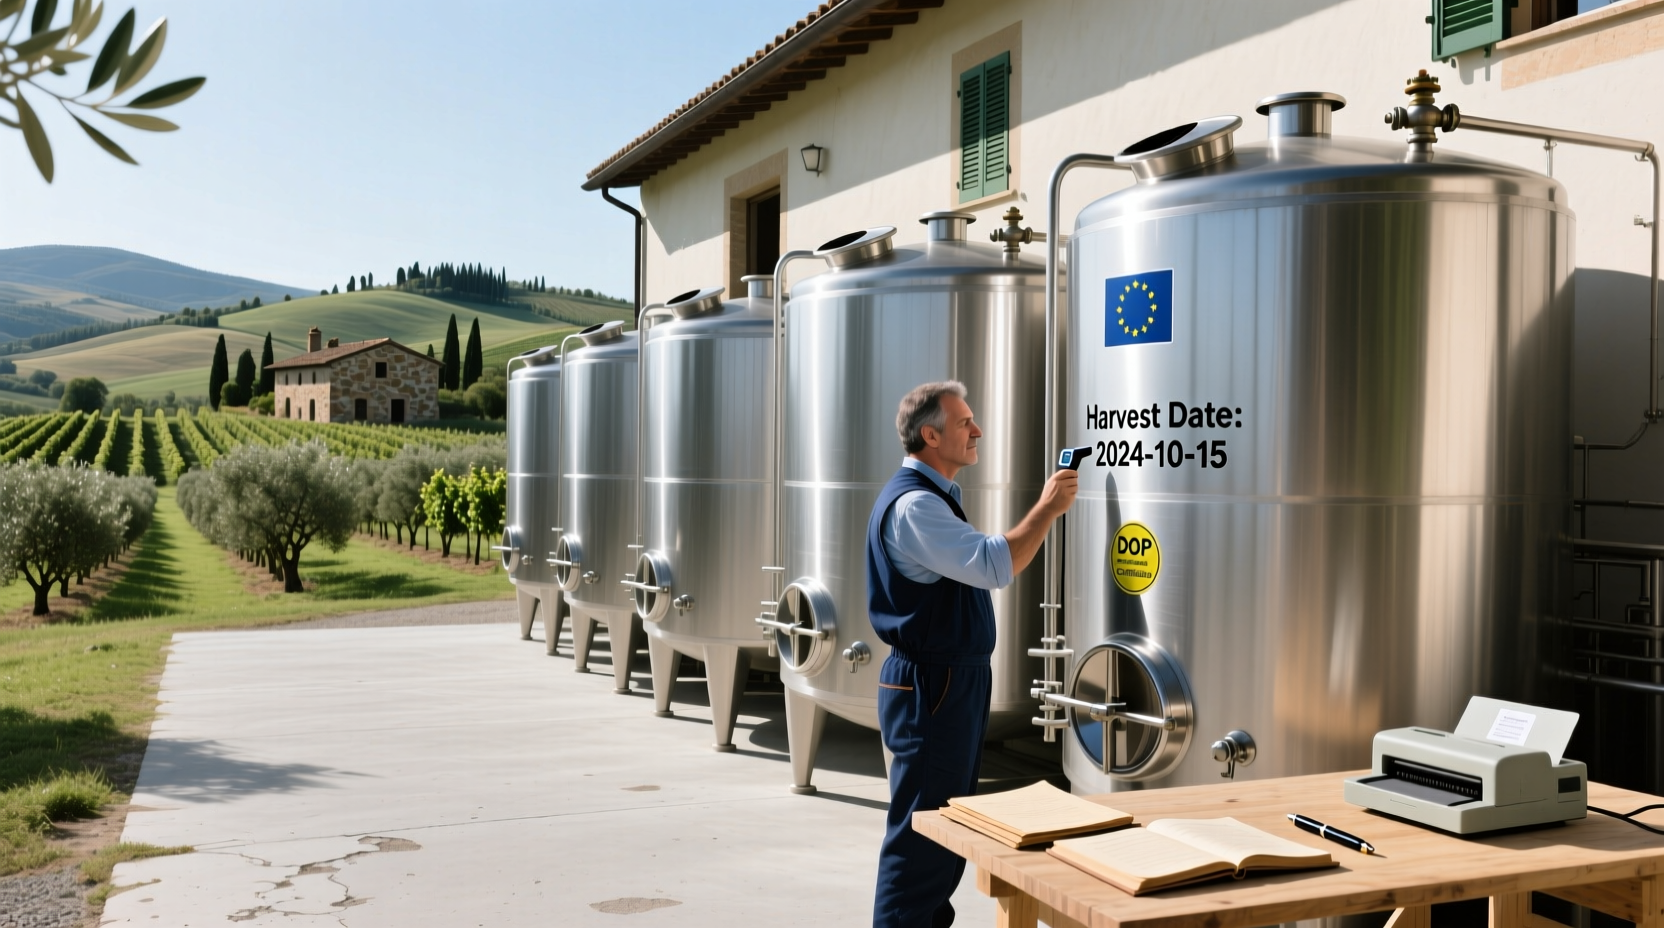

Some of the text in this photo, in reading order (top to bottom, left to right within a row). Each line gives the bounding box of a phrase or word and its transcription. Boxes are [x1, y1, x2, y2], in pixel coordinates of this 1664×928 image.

[1086, 401, 1242, 430] Harvest Date:
[1095, 439, 1228, 469] 2024-10-15
[1117, 535, 1153, 557] DOP
